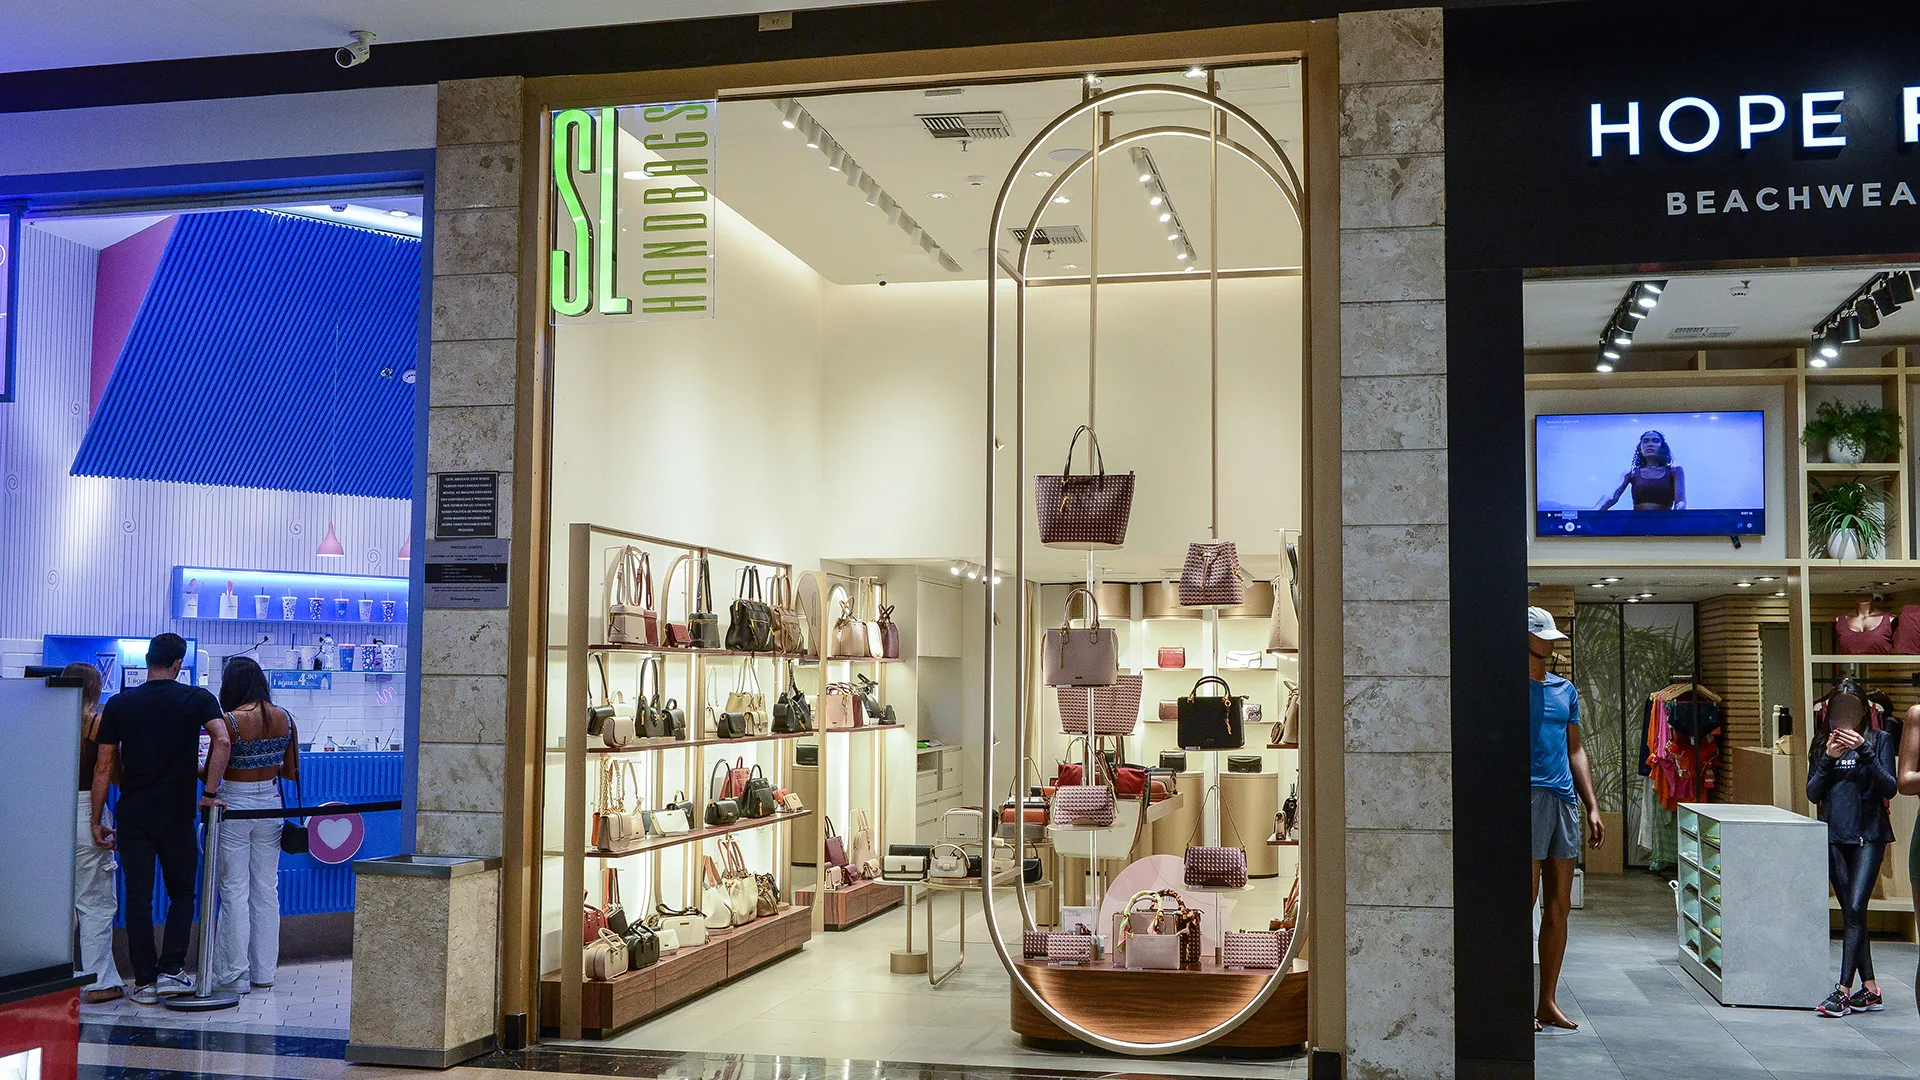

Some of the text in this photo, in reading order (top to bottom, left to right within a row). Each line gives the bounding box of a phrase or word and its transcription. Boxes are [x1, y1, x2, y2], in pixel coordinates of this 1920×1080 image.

[1590, 90, 1847, 158] HOPE
[551, 105, 631, 317] SL
[642, 104, 708, 313] HANDBAGS
[1666, 182, 1917, 216] BEACHWEA
